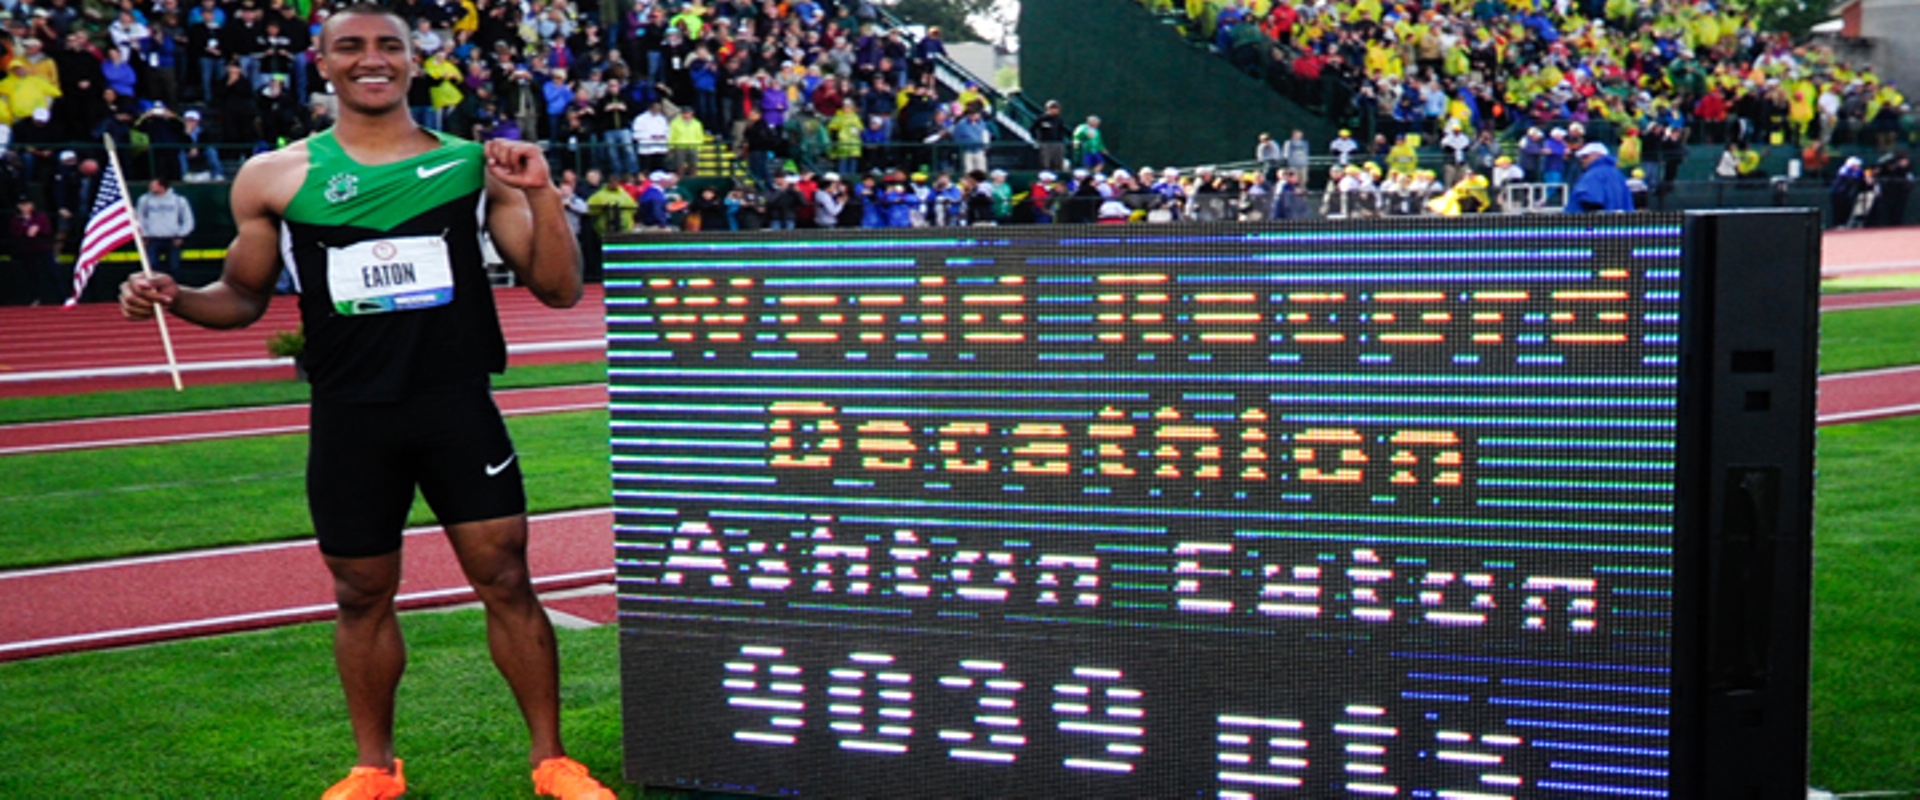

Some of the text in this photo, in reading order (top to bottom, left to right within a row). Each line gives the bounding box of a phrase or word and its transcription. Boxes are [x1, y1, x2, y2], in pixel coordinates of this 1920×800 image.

[361, 262, 416, 288] EATON
[647, 268, 1630, 344] World Record
[767, 401, 1464, 487] Decathlon
[661, 514, 1598, 631] Ashton Eaton
[721, 644, 1525, 800] 9039 pts
